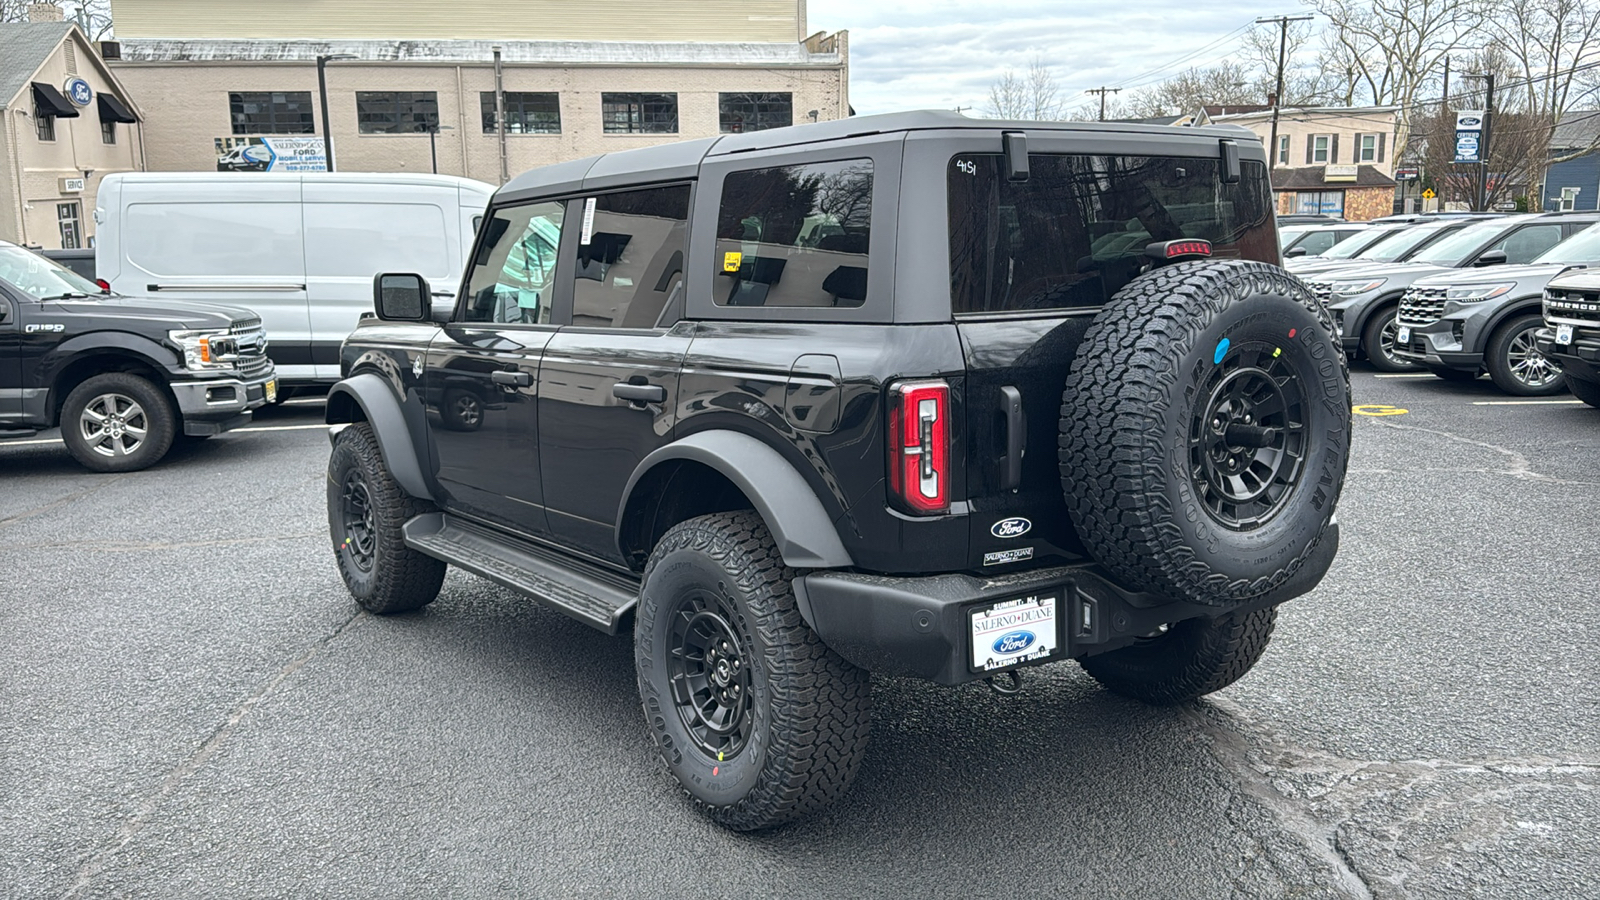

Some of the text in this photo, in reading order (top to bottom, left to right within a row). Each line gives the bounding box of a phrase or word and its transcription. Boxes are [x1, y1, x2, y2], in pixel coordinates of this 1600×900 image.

[76, 83, 89, 101] Ford
[956, 159, 976, 176] 4151
[67, 180, 83, 189] SERVICE
[1550, 301, 1597, 311] BRONCO
[999, 520, 1025, 535] Ford
[985, 552, 1009, 561] SALERNO
[1014, 549, 1031, 557] DUANE
[1027, 596, 1037, 604] NJ
[974, 606, 1053, 633] SALERNO DUANE
[1000, 633, 1028, 652] Ford
[984, 649, 1051, 671] SALERNO DUANE
